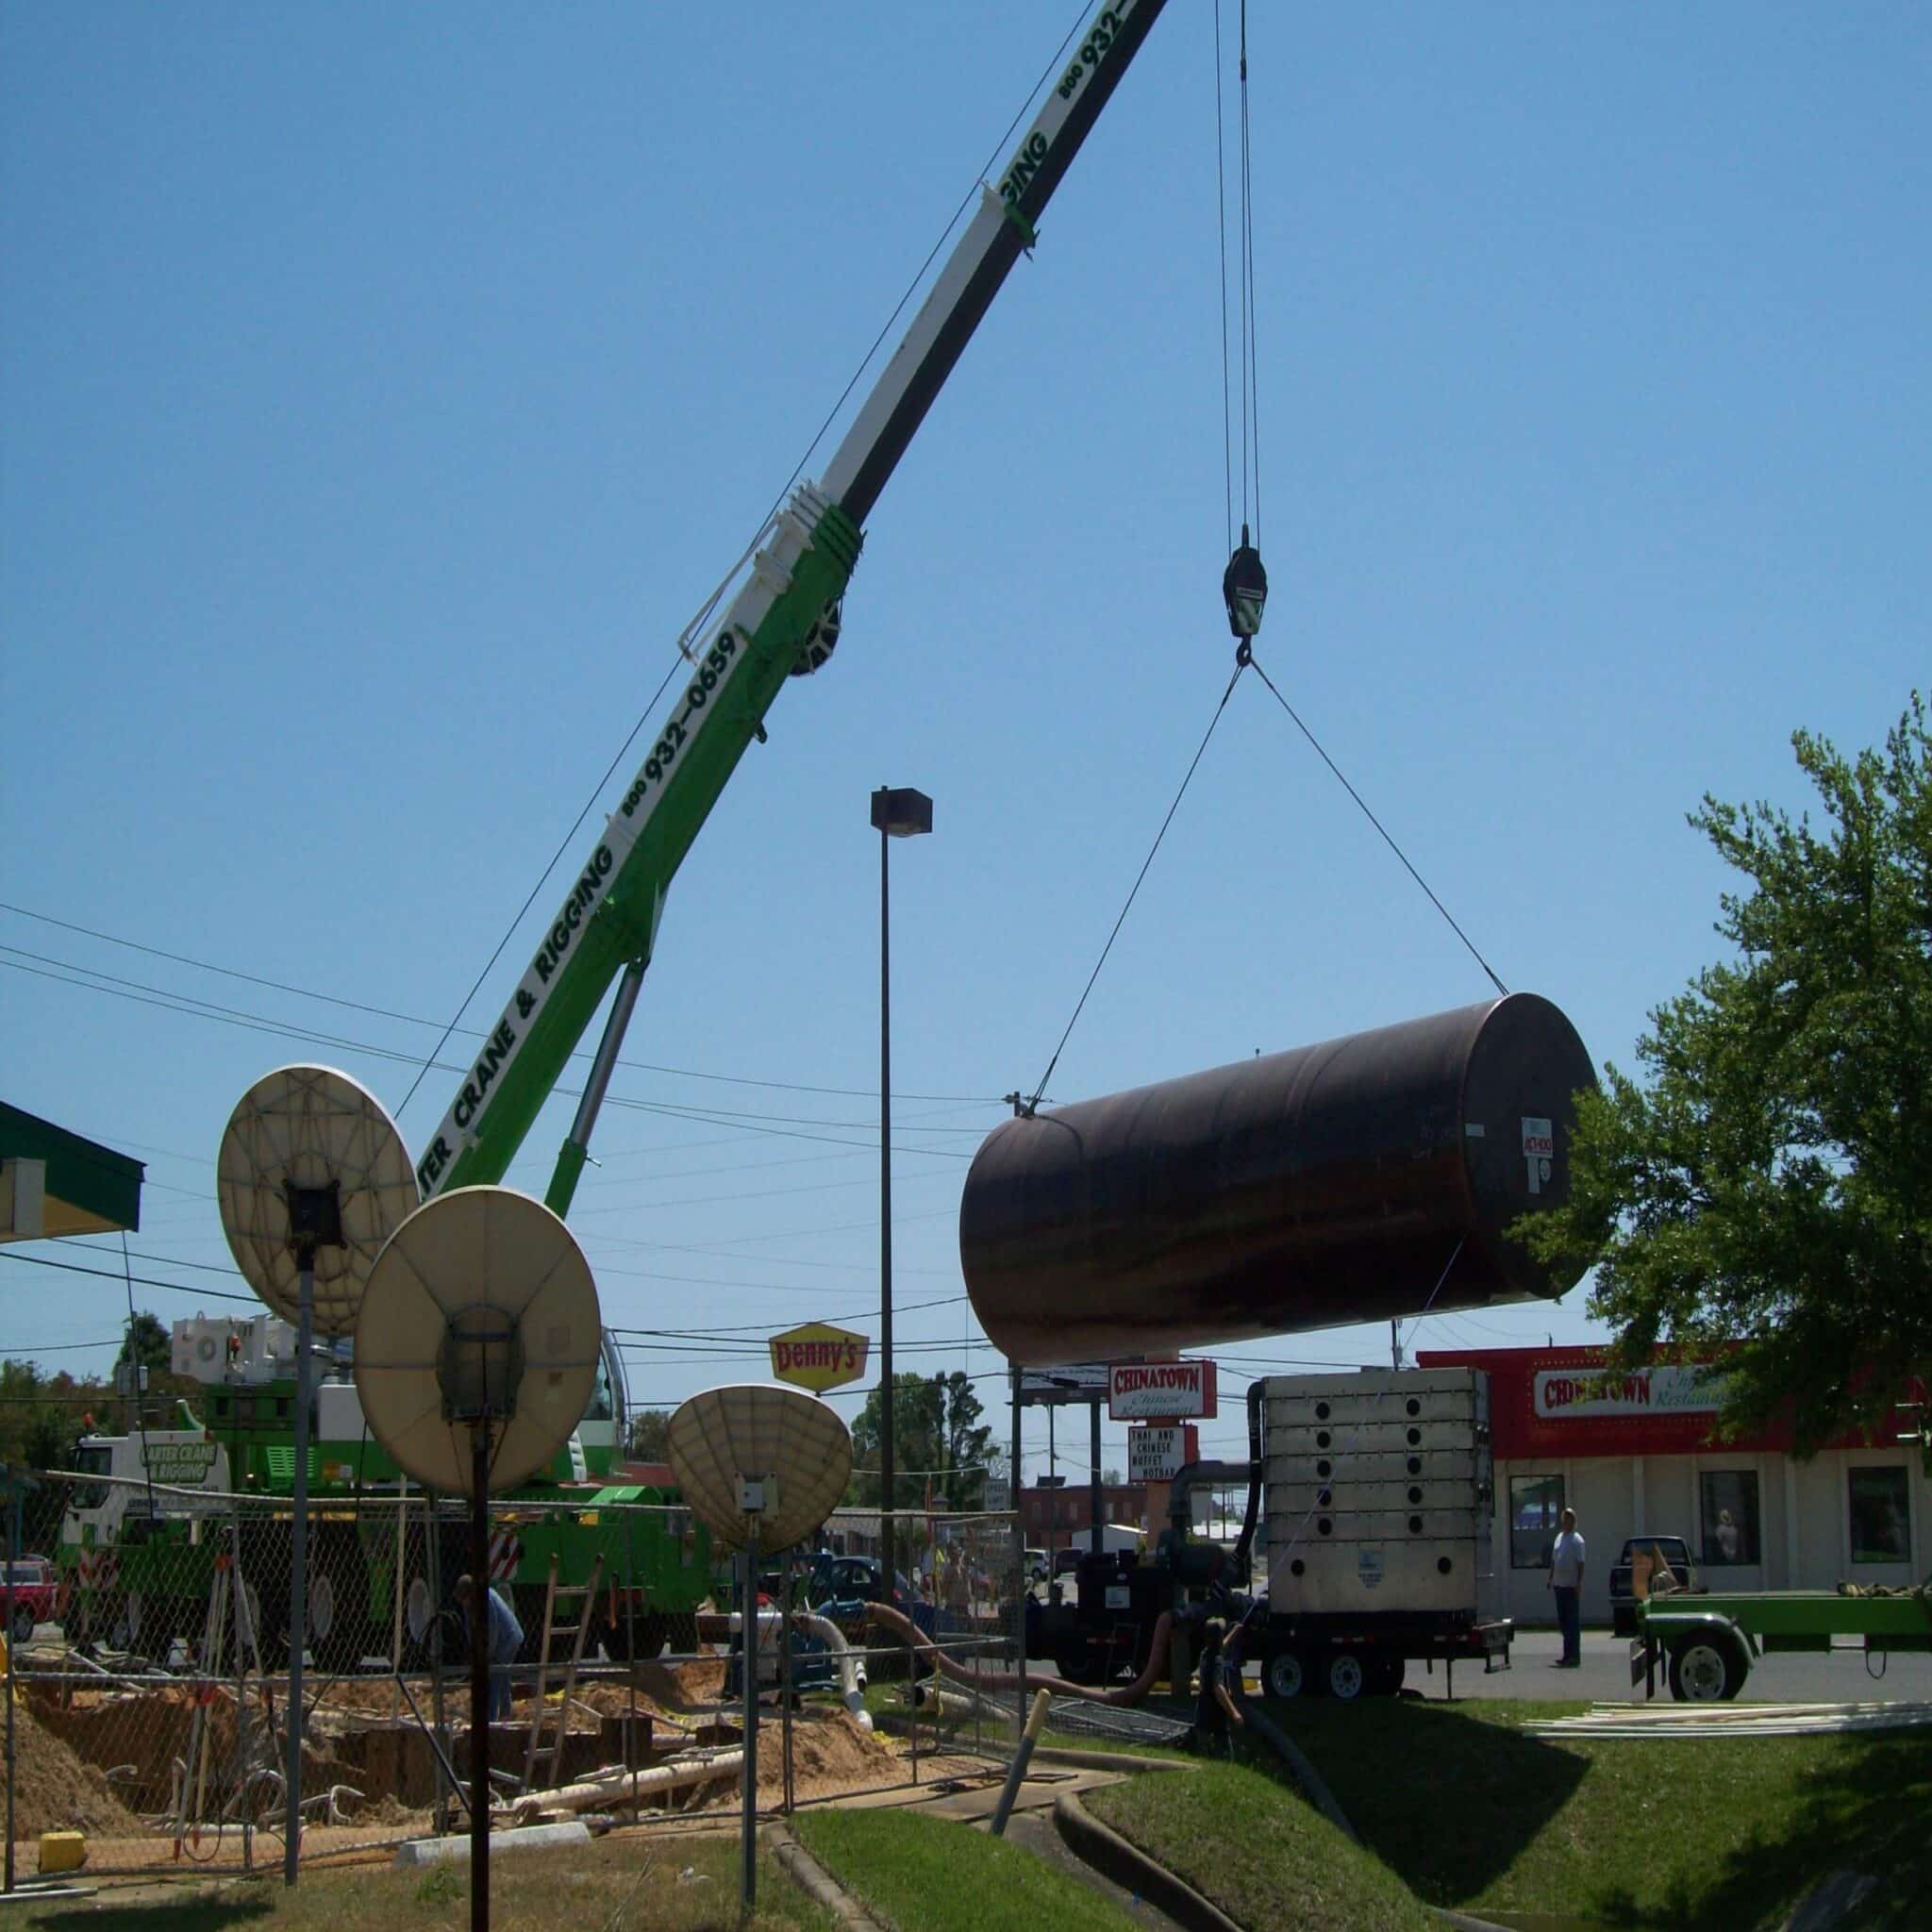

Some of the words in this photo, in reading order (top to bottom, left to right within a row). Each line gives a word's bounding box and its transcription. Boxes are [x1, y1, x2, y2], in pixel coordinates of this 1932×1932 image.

[1058, 64, 1084, 100] 800
[454, 1017, 516, 1131] CRANE
[515, 989, 538, 1021] &
[535, 842, 614, 986] RIGGING
[622, 778, 648, 819] 800
[643, 629, 738, 786] 932-0659
[775, 1336, 858, 1374] Denny's
[1114, 1367, 1200, 1396] CHINATOWN
[1132, 1430, 1152, 1442] THAI
[1158, 1430, 1174, 1441] AND
[179, 1444, 215, 1463] CRANE
[1137, 1442, 1171, 1454] CHINESE
[1132, 1455, 1162, 1466] BUFFET
[158, 1464, 206, 1481] RIGGING
